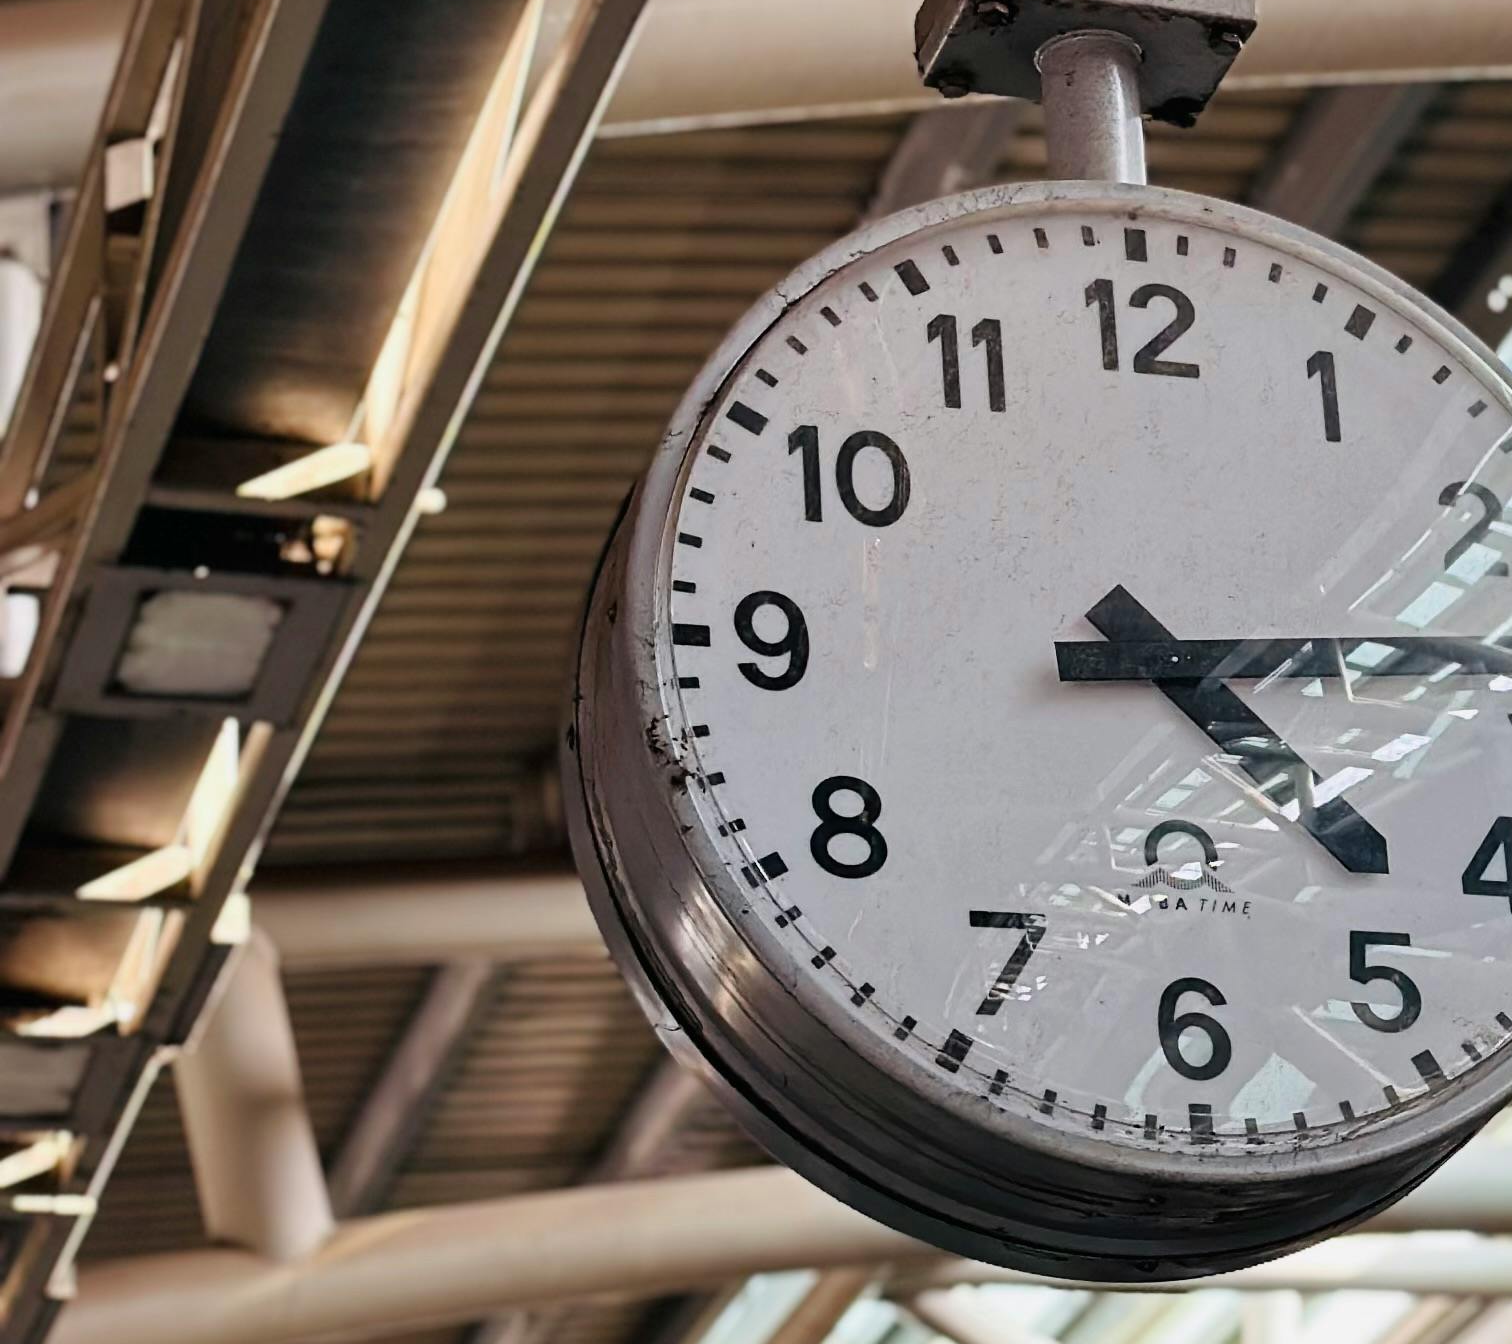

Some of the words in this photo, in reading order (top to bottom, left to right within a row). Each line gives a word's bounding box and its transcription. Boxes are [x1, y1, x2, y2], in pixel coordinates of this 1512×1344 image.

[926, 313, 1007, 413] 11
[1084, 278, 1201, 379] 12
[1306, 350, 1342, 443] 1
[787, 424, 911, 528] 10
[1438, 481, 1509, 577] 2
[733, 590, 810, 692] 9
[809, 775, 889, 880] 8
[968, 910, 1047, 1016] 7
[1349, 929, 1423, 1034] 5
[1157, 976, 1232, 1082] 6
